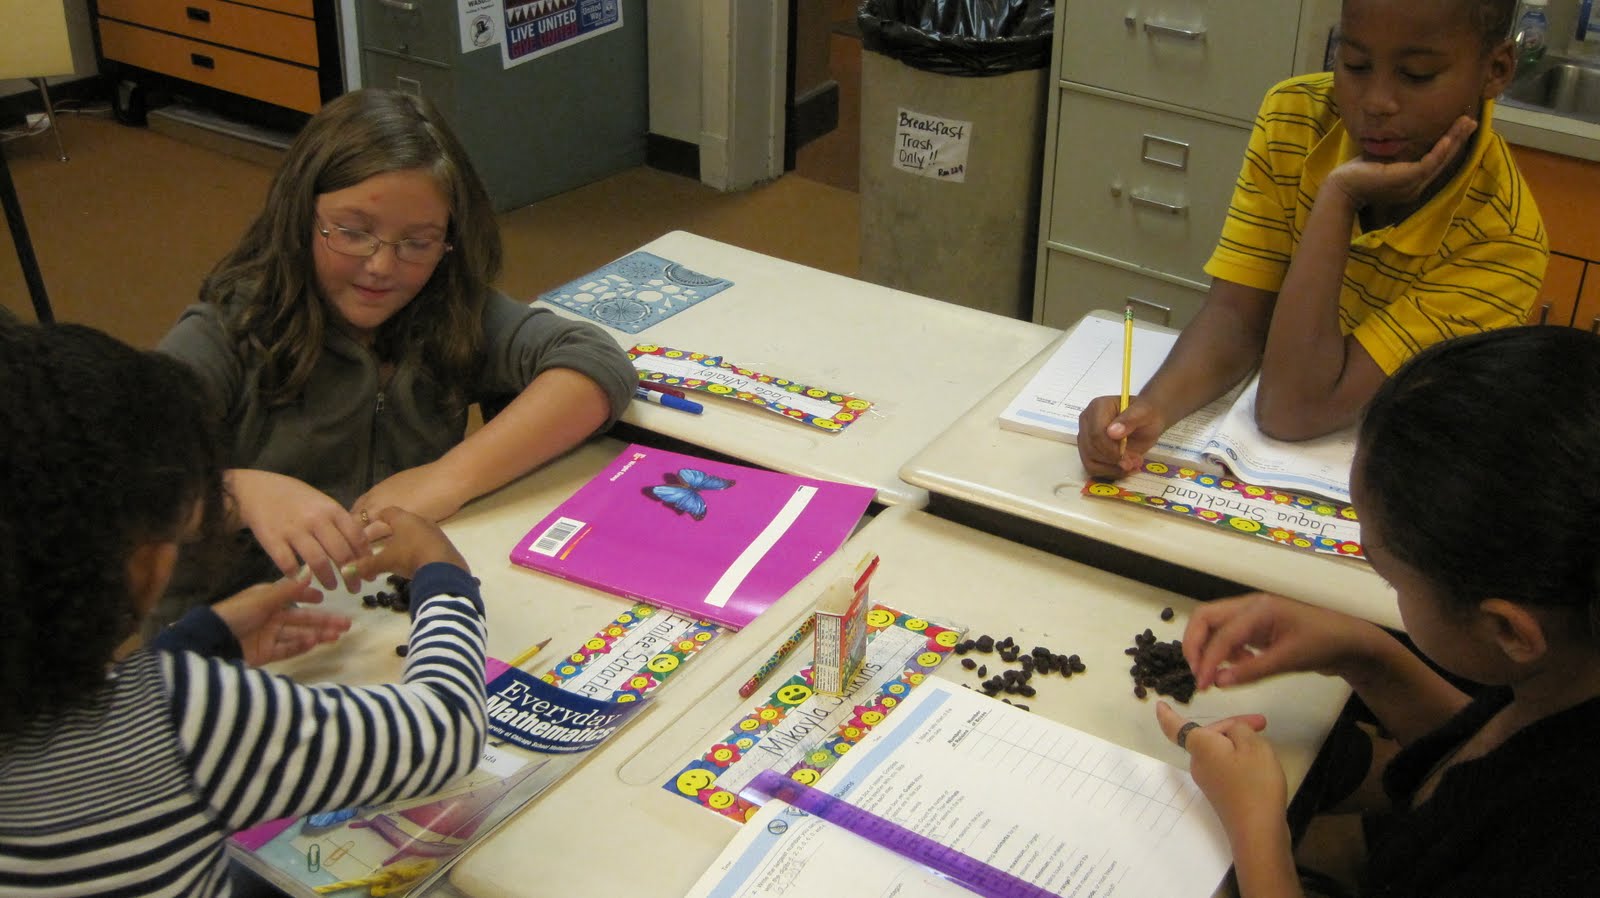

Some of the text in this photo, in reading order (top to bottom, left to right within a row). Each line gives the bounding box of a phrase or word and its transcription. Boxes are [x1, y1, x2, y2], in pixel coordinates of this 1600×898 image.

[510, 24, 535, 44] LIVE
[538, 9, 577, 34] UNITED
[900, 112, 964, 140] Breakfast
[900, 132, 932, 150] Trash
[899, 149, 924, 169] Only
[694, 368, 748, 393] Whaley
[1163, 484, 1337, 538] Jaqua Strickland
[636, 613, 692, 650] Emilee
[486, 694, 616, 746] Mathematics
[496, 679, 622, 729] Everyday
[511, 733, 531, 746] Chicago
[532, 740, 550, 750] School
[759, 704, 832, 757] Mikayla
